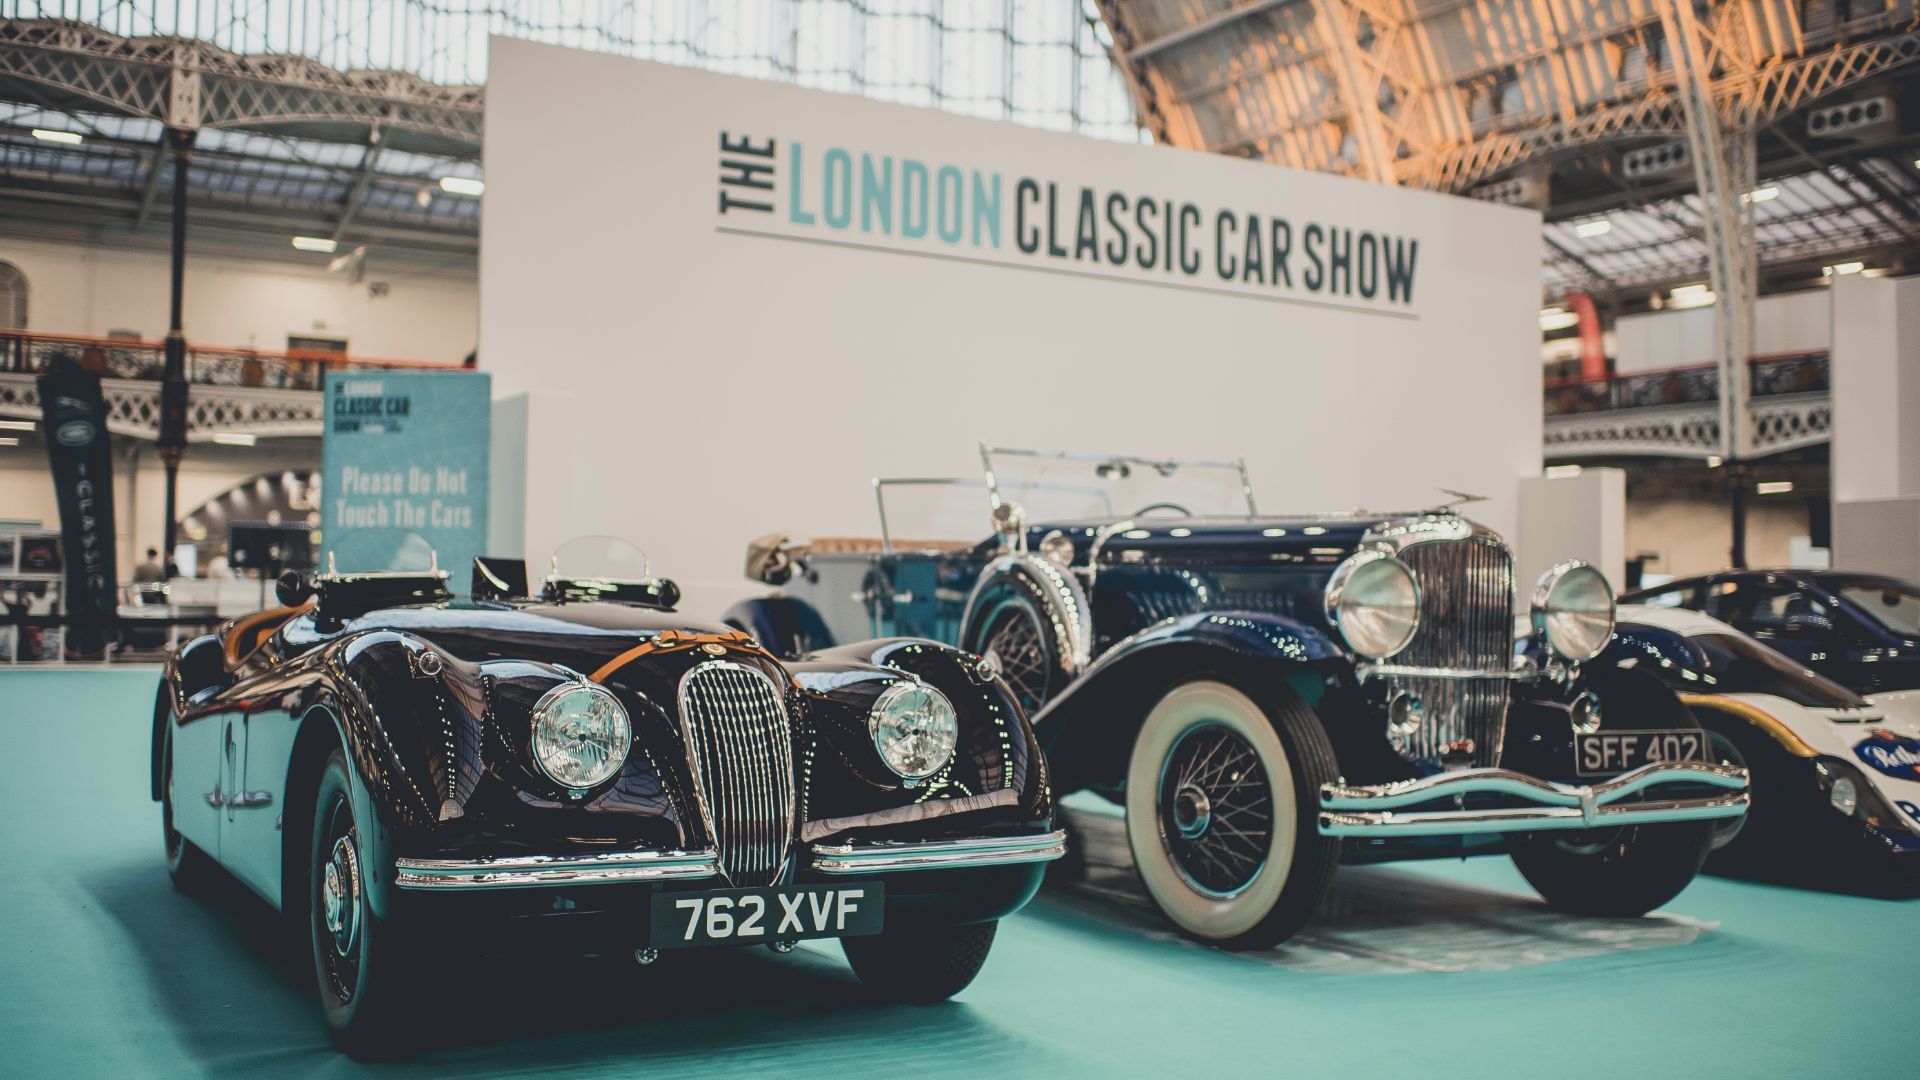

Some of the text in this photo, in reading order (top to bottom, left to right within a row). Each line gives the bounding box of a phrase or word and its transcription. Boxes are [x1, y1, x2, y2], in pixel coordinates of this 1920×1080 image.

[719, 131, 1418, 304] THE LONDON CLASSIC CAR SHOW
[334, 397, 410, 417] CLASSIC CAR
[342, 466, 402, 495] Please
[409, 466, 430, 494] Do
[436, 466, 466, 495] Not
[336, 499, 471, 528] Touch The Cars
[77, 480, 104, 589] CLASSIC
[1584, 735, 1698, 769] SFF 402
[676, 889, 864, 940] 762 XVF
